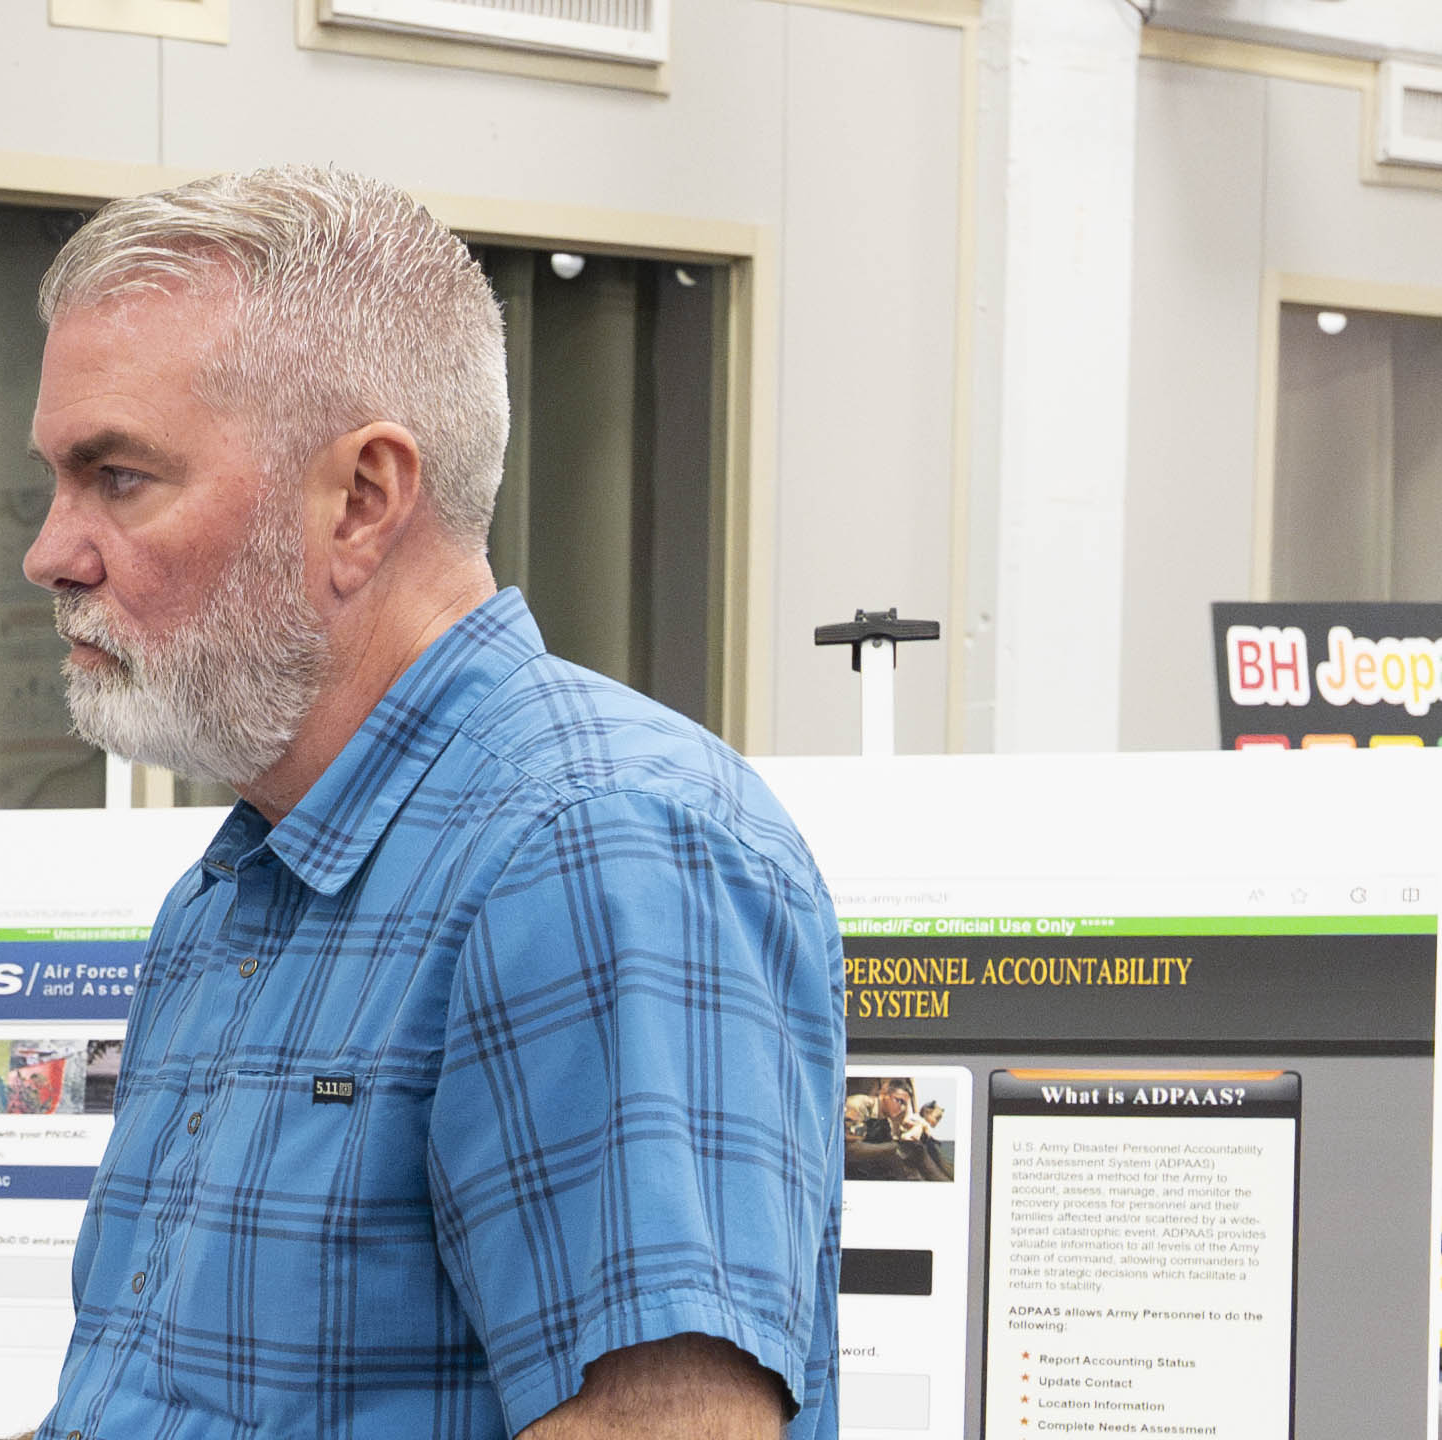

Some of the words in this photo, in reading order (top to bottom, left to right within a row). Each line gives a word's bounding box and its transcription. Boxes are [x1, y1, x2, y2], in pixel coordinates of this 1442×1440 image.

[1234, 636, 1302, 695] BH
[1323, 636, 1442, 706] Jeop
[838, 919, 930, 934] ssified//For
[935, 919, 995, 934] Official
[999, 919, 1031, 934] Use
[1036, 919, 1076, 936] Only
[43, 963, 72, 979] Air
[76, 963, 129, 980] Force
[843, 957, 975, 985] PERSONNEL
[981, 957, 1193, 986] ACCOUNTABILITY
[43, 982, 74, 996] and
[81, 981, 134, 997] Asse
[858, 990, 951, 1019] SYSTEM
[1040, 1086, 1100, 1104] What
[1108, 1087, 1125, 1104] is
[1132, 1087, 1246, 1106] ADPAAS?
[1008, 1305, 1061, 1317] ADPAAS
[1064, 1307, 1103, 1318] allows
[1106, 1308, 1139, 1321] Army
[1142, 1308, 1205, 1320] Personnel
[1208, 1311, 1221, 1321] to
[1224, 1311, 1240, 1321] do
[1243, 1311, 1263, 1321] the
[1008, 1319, 1067, 1334] following:
[841, 1346, 881, 1358] word.
[1039, 1354, 1080, 1367] Report
[1082, 1355, 1153, 1370] Accounting
[1157, 1357, 1196, 1368] Status
[1038, 1376, 1081, 1389] Update
[1084, 1377, 1132, 1389] Contact
[1038, 1398, 1091, 1409] Location
[1094, 1400, 1165, 1412] Information
[1037, 1419, 1095, 1433] Complete
[1098, 1422, 1137, 1433] Needs
[1140, 1423, 1216, 1436] Assessment
